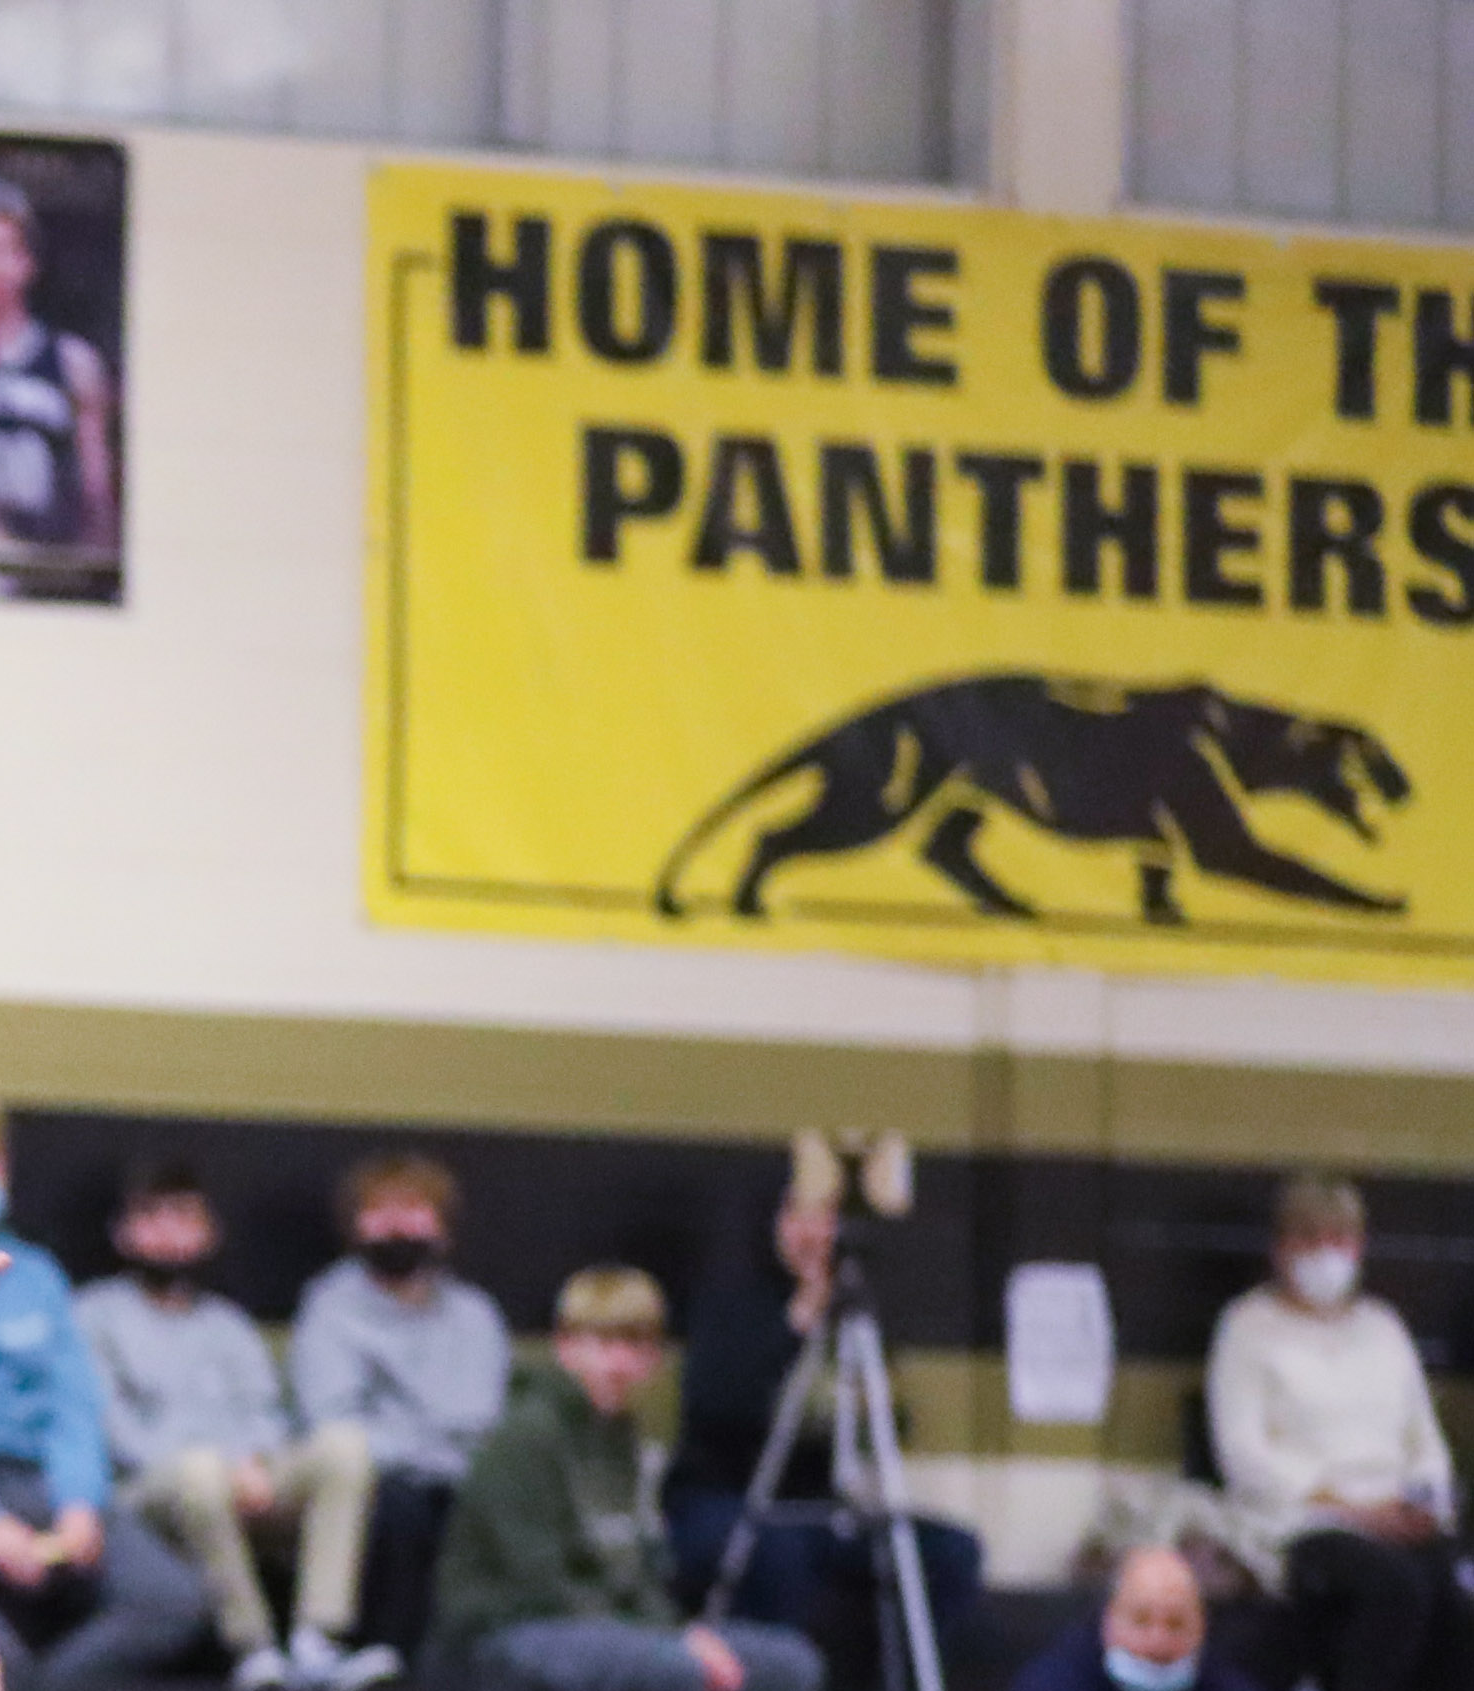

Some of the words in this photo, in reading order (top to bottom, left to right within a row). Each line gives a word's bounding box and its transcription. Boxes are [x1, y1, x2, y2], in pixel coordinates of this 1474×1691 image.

[447, 205, 960, 386] HOME
[1039, 253, 1248, 407] OF
[576, 419, 1474, 628] PANTHERS
